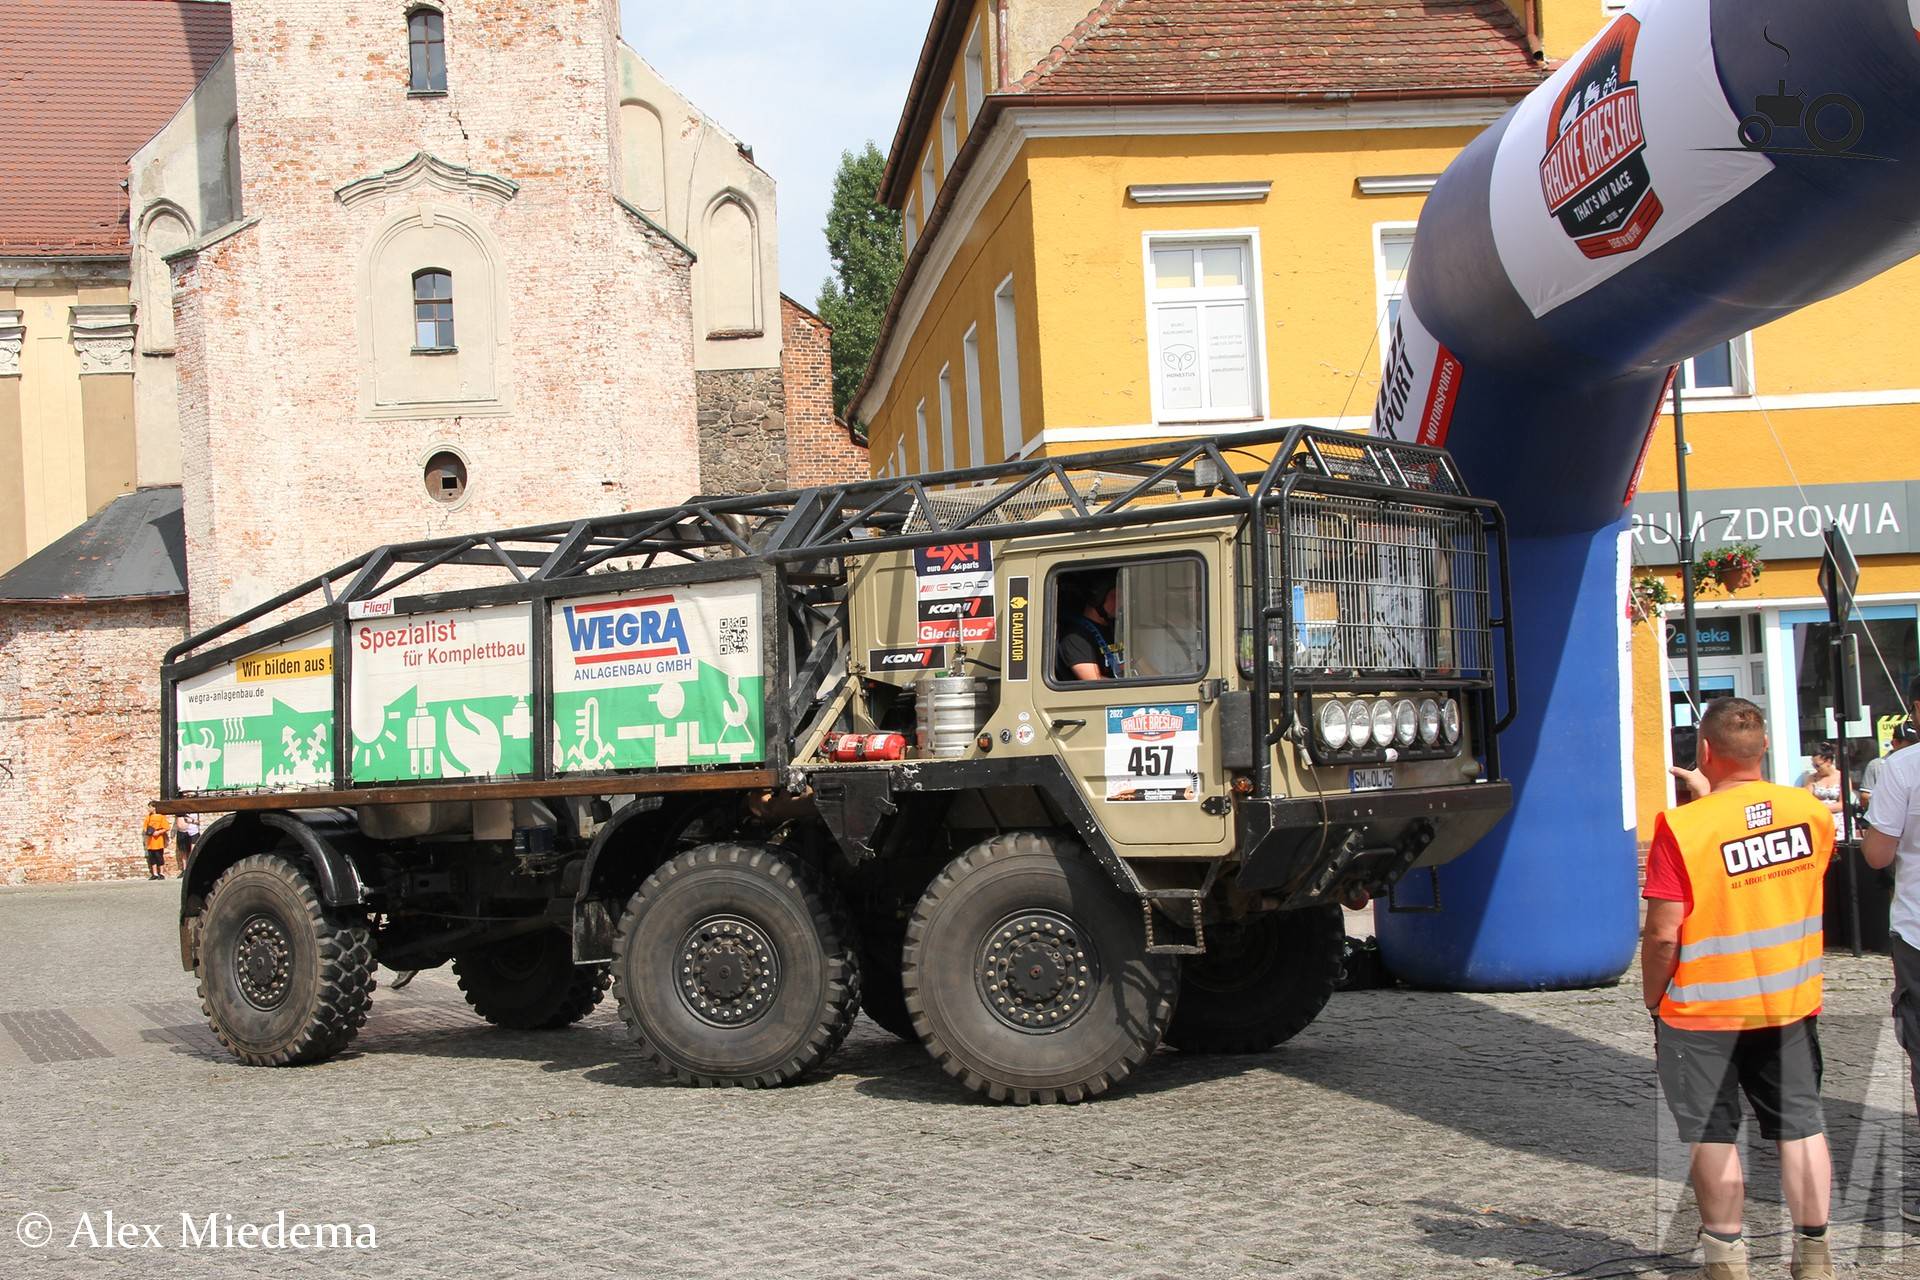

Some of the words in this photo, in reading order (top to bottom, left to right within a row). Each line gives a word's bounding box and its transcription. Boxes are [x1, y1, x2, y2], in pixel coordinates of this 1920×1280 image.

[1544, 126, 1586, 204] RALLYE
[1582, 95, 1639, 173] BRESLAU
[1573, 195, 1600, 222] THAT'S
[1597, 185, 1611, 206] MY
[1609, 170, 1633, 197] RACE
[1426, 358, 1455, 443] MOTORSPORTS
[1720, 501, 1900, 541] ZDROWIA
[363, 599, 392, 614] Fliegl
[928, 602, 971, 614] KONI
[359, 619, 457, 654] Spezialist
[563, 607, 690, 655] WEGRA
[1012, 612, 1024, 662] GLADIATOR
[1676, 628, 1730, 644] ateka
[403, 649, 421, 667] für
[428, 641, 526, 667] Komplettbau
[882, 652, 923, 665] KONI
[242, 661, 260, 678] Wir
[264, 657, 300, 676] bilden
[304, 659, 325, 673] aus
[574, 662, 651, 681] ANLAGENBAU
[656, 658, 692, 674] GMBH
[188, 688, 265, 704] wegra-anlagenbau.de
[1109, 709, 1123, 719] 2022
[1123, 716, 1148, 731] RALLYE
[1149, 715, 1181, 730] BRESLAU
[1128, 746, 1174, 776] 457
[1355, 771, 1366, 788] SM
[1383, 769, 1393, 786] 75
[1748, 816, 1772, 829] SPORT
[1723, 827, 1811, 874] ORGA
[1744, 874, 1766, 886] ABOUT
[1767, 863, 1815, 879] MOTORSPORTS
